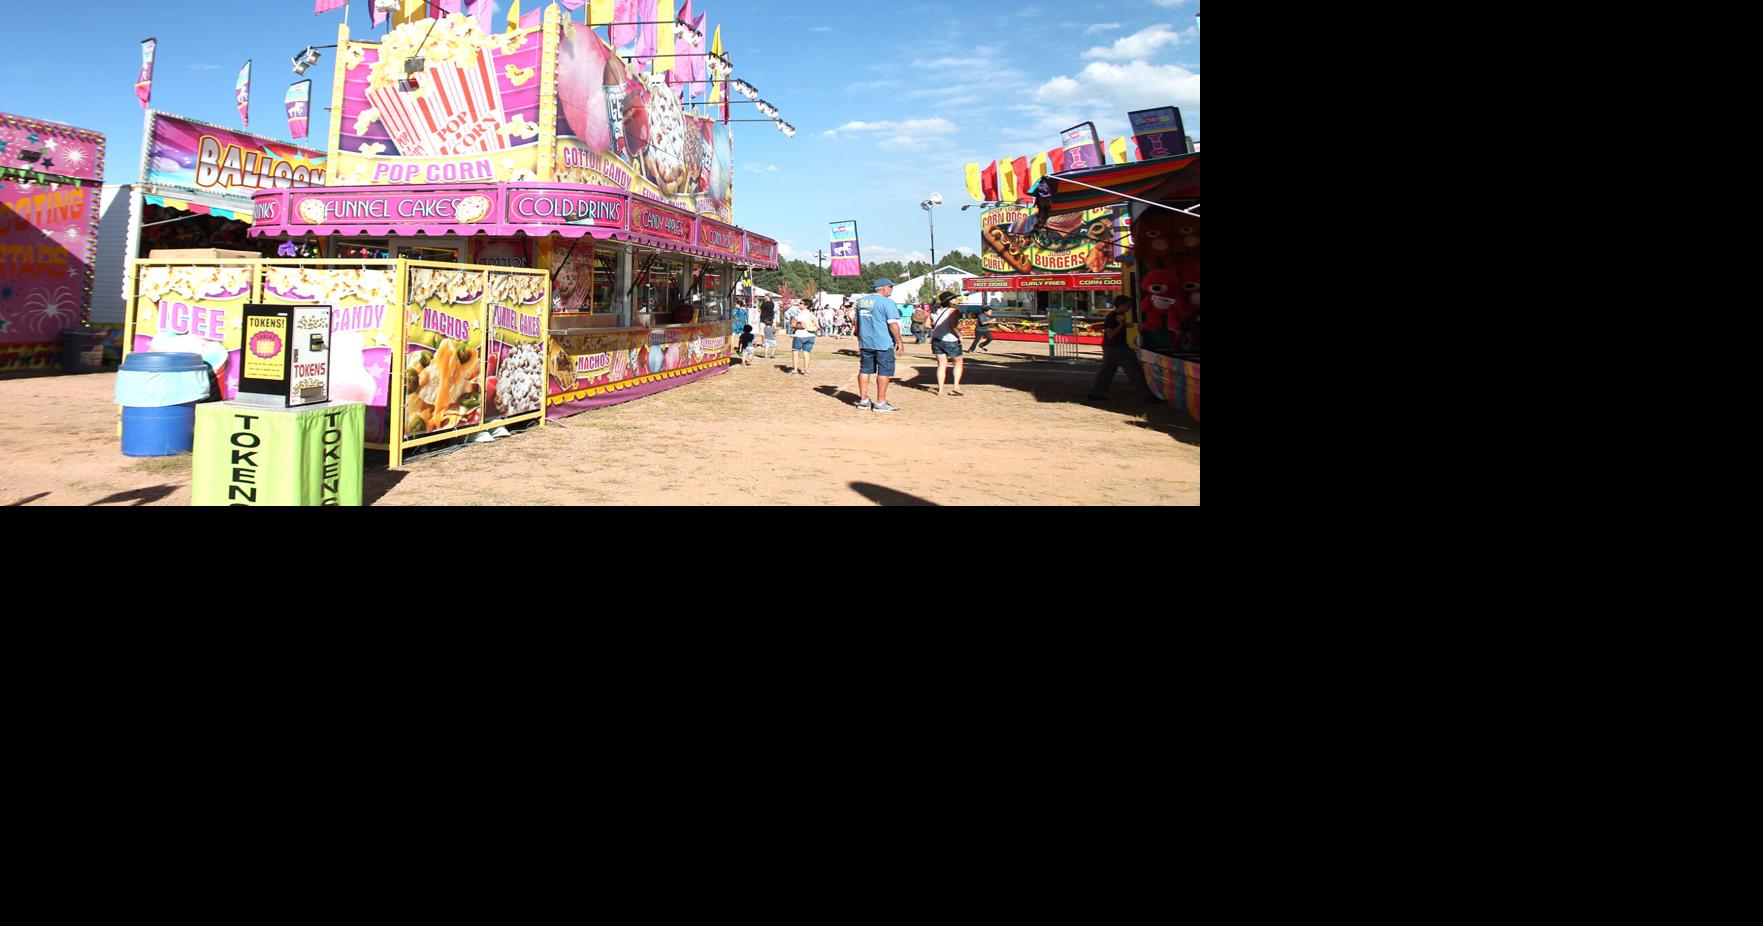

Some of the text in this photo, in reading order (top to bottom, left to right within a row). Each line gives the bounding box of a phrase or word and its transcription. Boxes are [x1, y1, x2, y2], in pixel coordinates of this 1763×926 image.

[373, 160, 493, 182] POP CORN
[603, 159, 632, 192] CANDY
[324, 198, 461, 217] FUNNEL CAKES
[518, 196, 621, 221] COLD DRINKS
[983, 257, 1005, 270] CURLY
[1035, 251, 1086, 269] BURGERS
[158, 300, 225, 340] ICEE
[249, 317, 285, 329] TOKENS!
[331, 304, 385, 334] CANDY
[422, 307, 470, 342] NACHOS
[520, 313, 541, 338] CAKES
[293, 362, 326, 378] TOKENS
[577, 352, 611, 373] NACHOS
[228, 414, 261, 506] TOKEN
